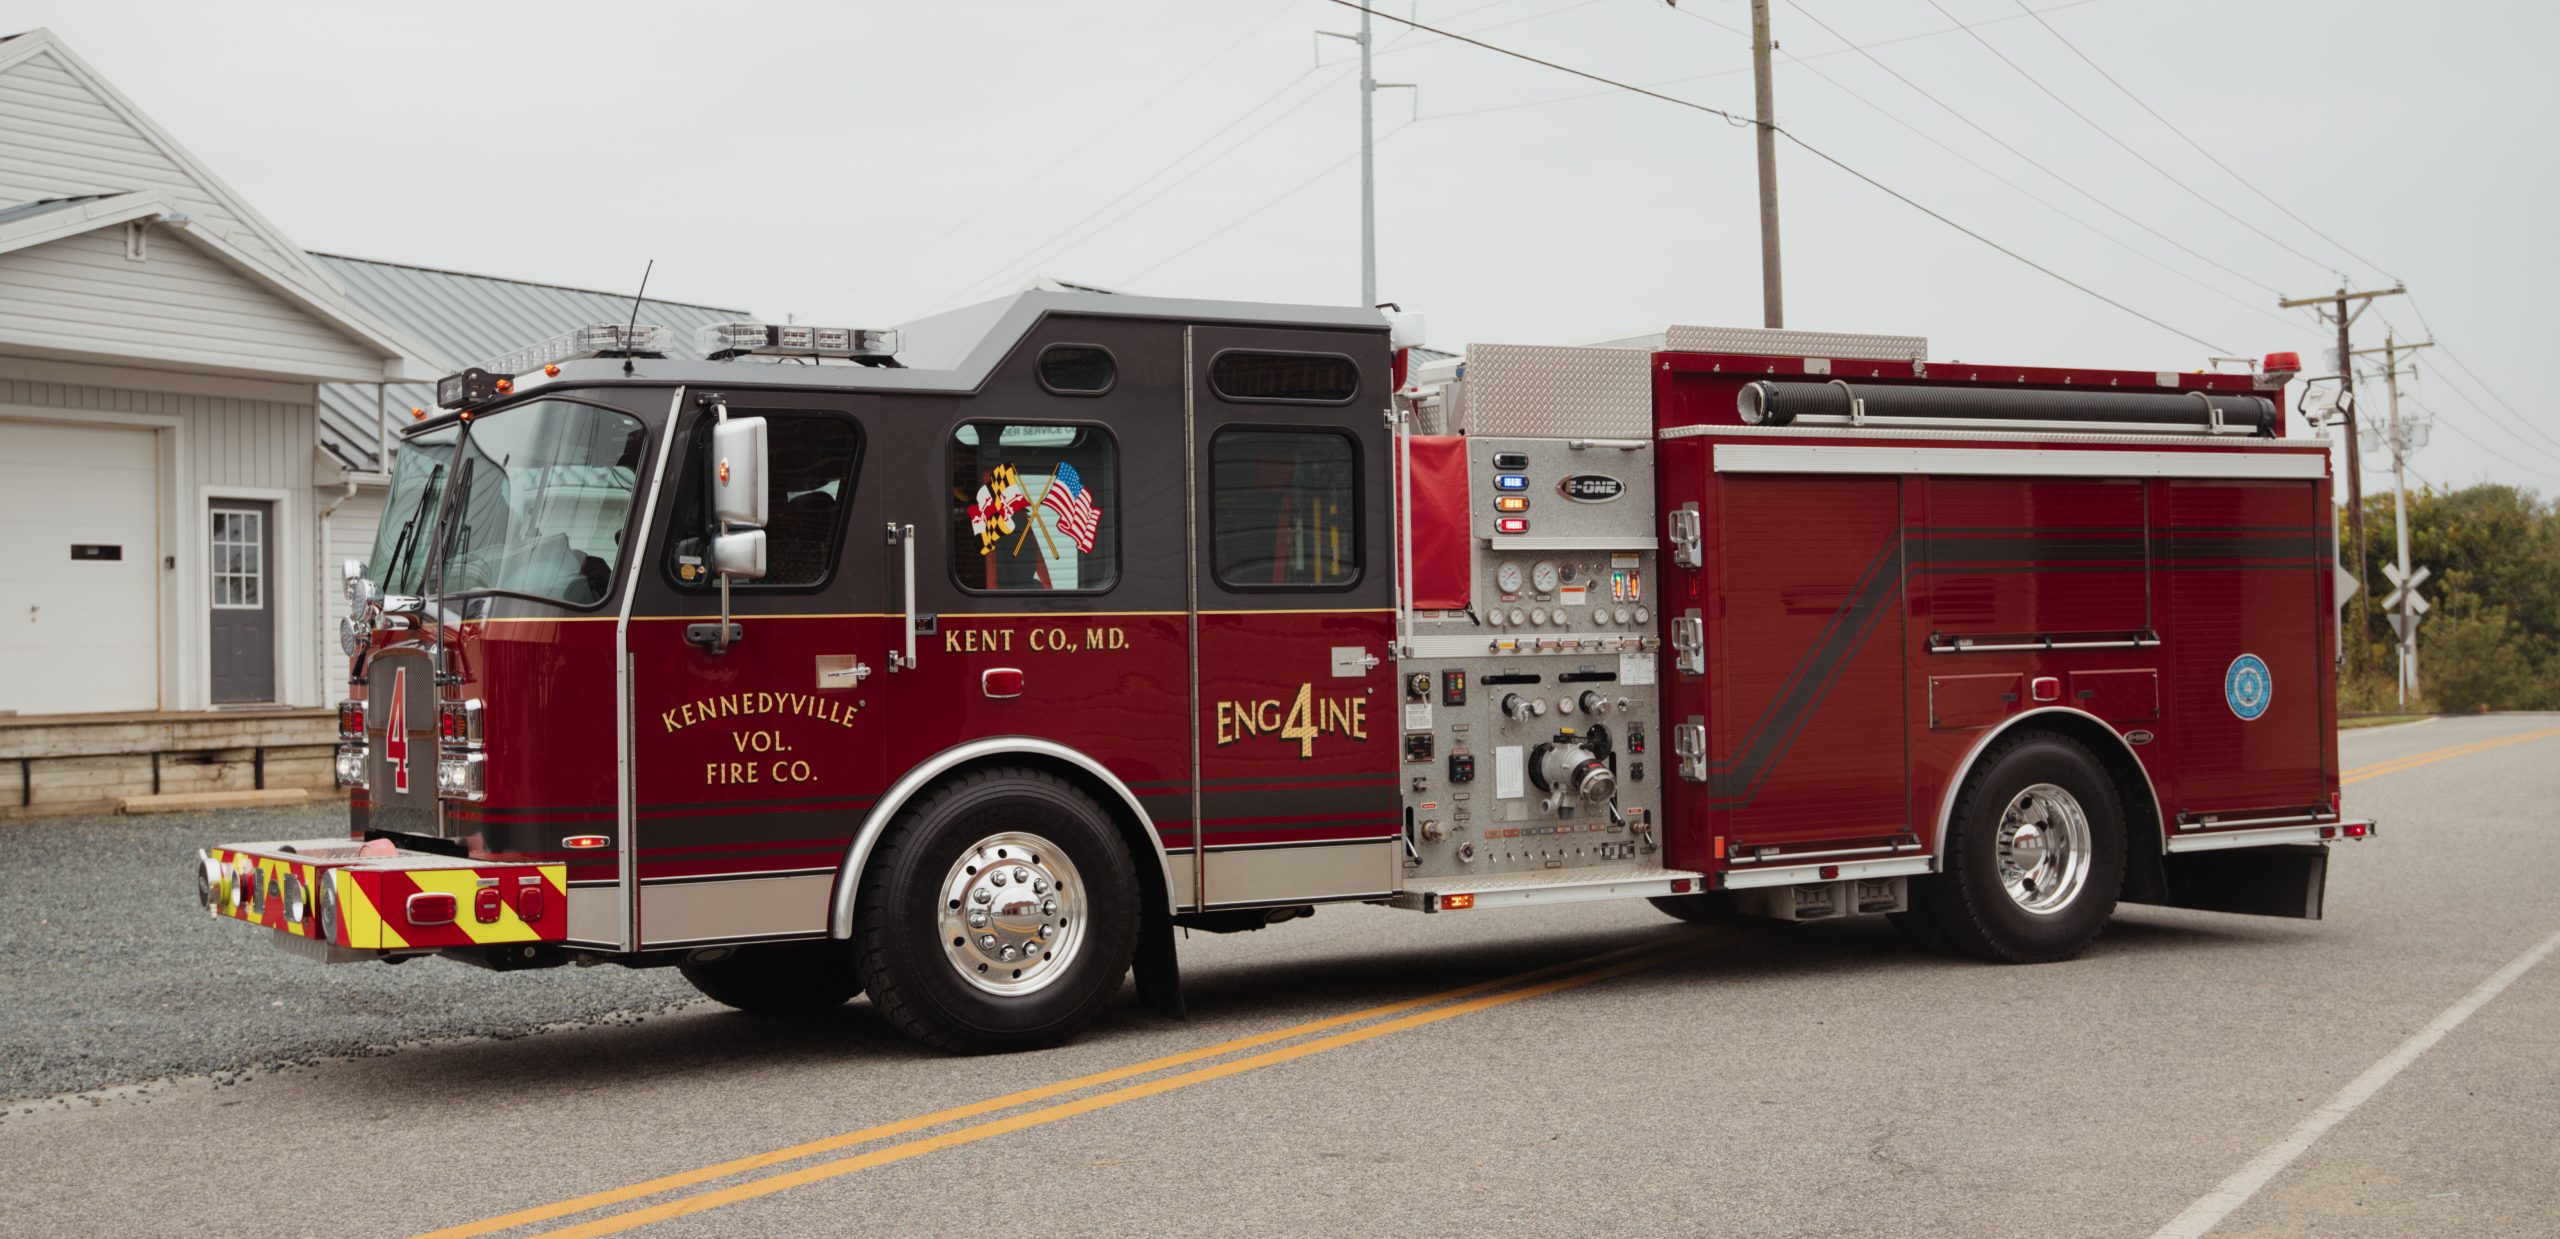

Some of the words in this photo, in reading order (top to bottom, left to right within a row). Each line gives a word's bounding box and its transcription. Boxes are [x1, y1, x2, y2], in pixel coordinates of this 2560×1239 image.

[1023, 426, 1062, 436] SERVICE
[1565, 481, 1617, 494] E-ONE
[945, 629, 1014, 652] KENT
[1030, 628, 1077, 653] CO.,
[1086, 628, 1130, 650] MD.
[662, 692, 858, 733] KENNEDYVILLE
[386, 666, 409, 794] 4
[733, 731, 792, 752] VOL.
[707, 762, 759, 784] FIRE
[772, 760, 818, 782] CO.
